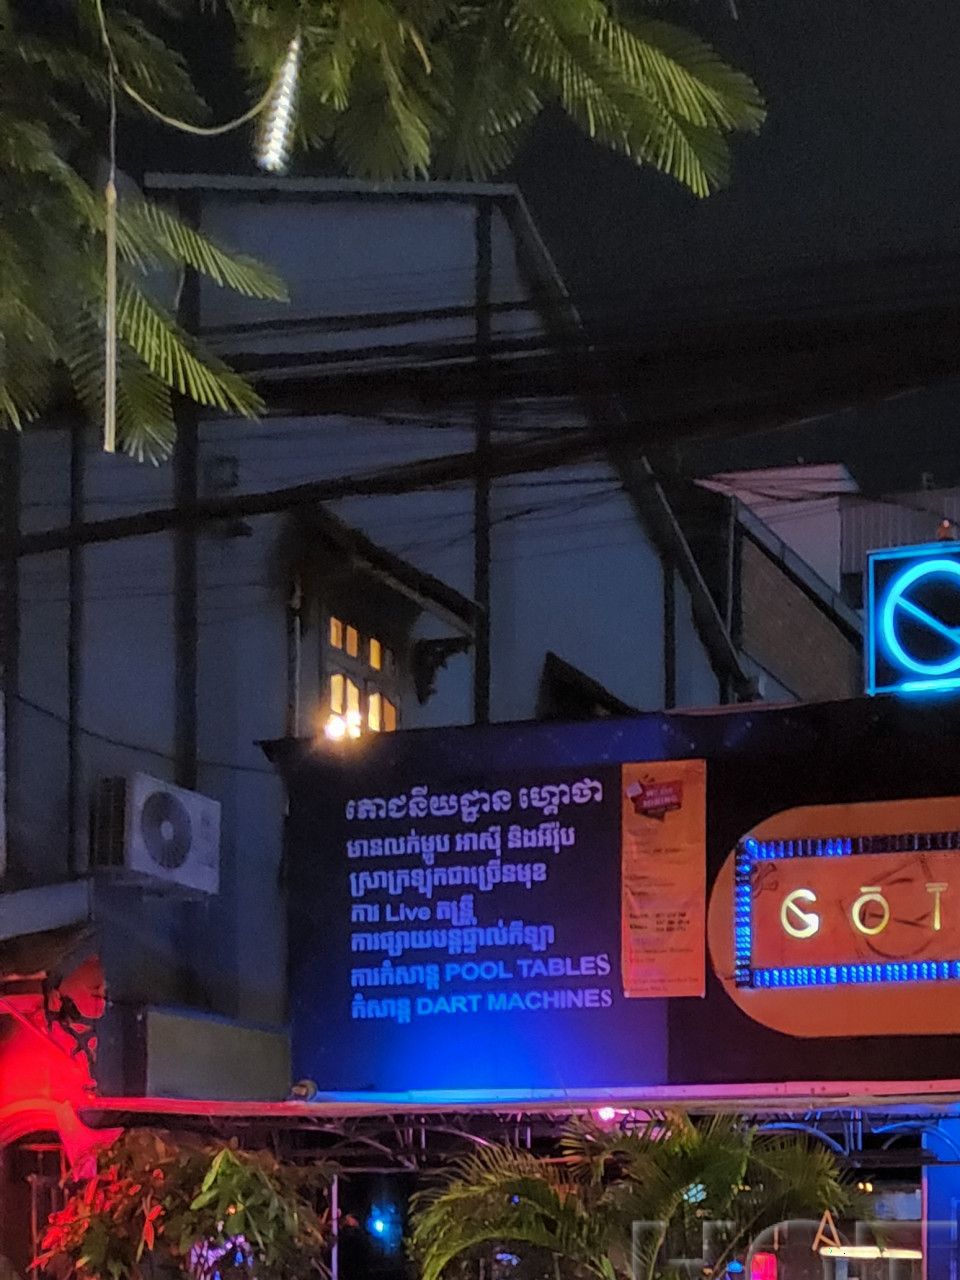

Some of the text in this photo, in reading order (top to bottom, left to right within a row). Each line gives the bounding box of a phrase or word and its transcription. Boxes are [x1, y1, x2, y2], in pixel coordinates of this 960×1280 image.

[385, 903, 432, 922] Live
[445, 961, 513, 982] POOL
[517, 954, 611, 978] TABLES
[416, 994, 483, 1016] DART
[488, 989, 613, 1011] MACHINES
